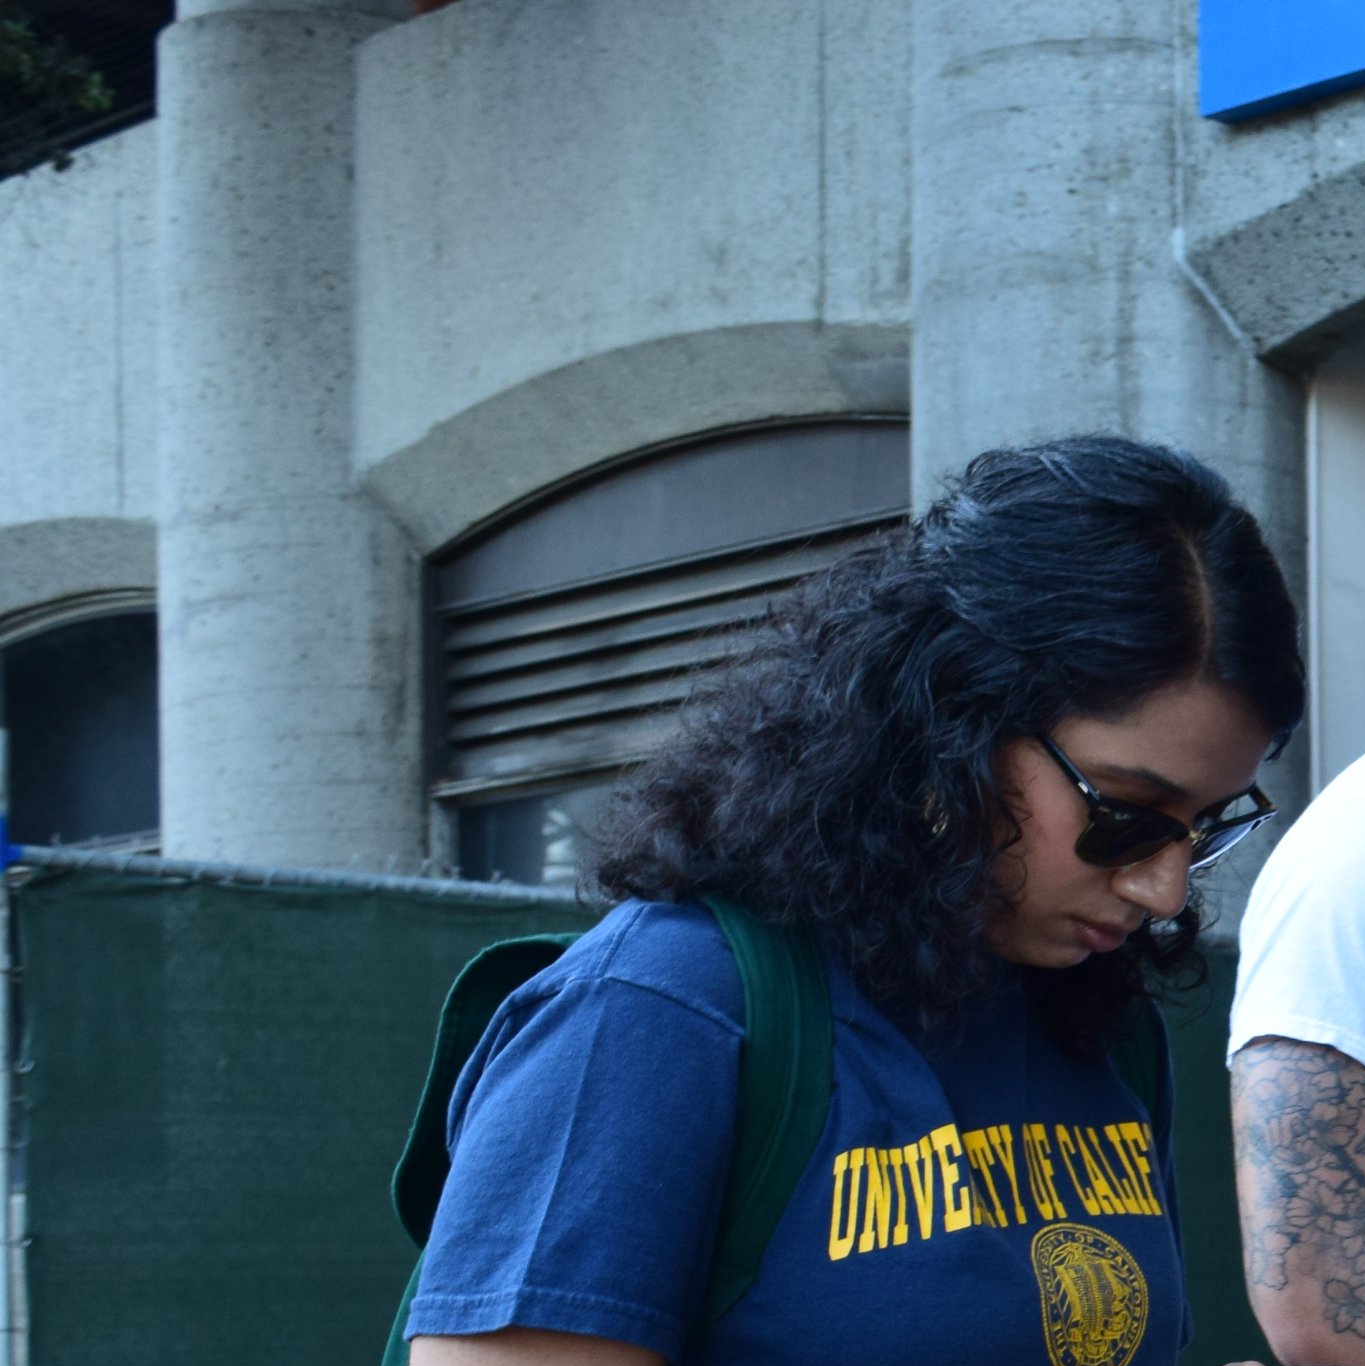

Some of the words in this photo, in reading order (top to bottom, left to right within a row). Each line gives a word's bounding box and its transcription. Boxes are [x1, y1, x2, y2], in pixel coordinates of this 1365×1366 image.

[828, 1123, 1027, 1261] UNIVETY
[1022, 1123, 1067, 1220] OF
[1056, 1122, 1163, 1216] CALIF
